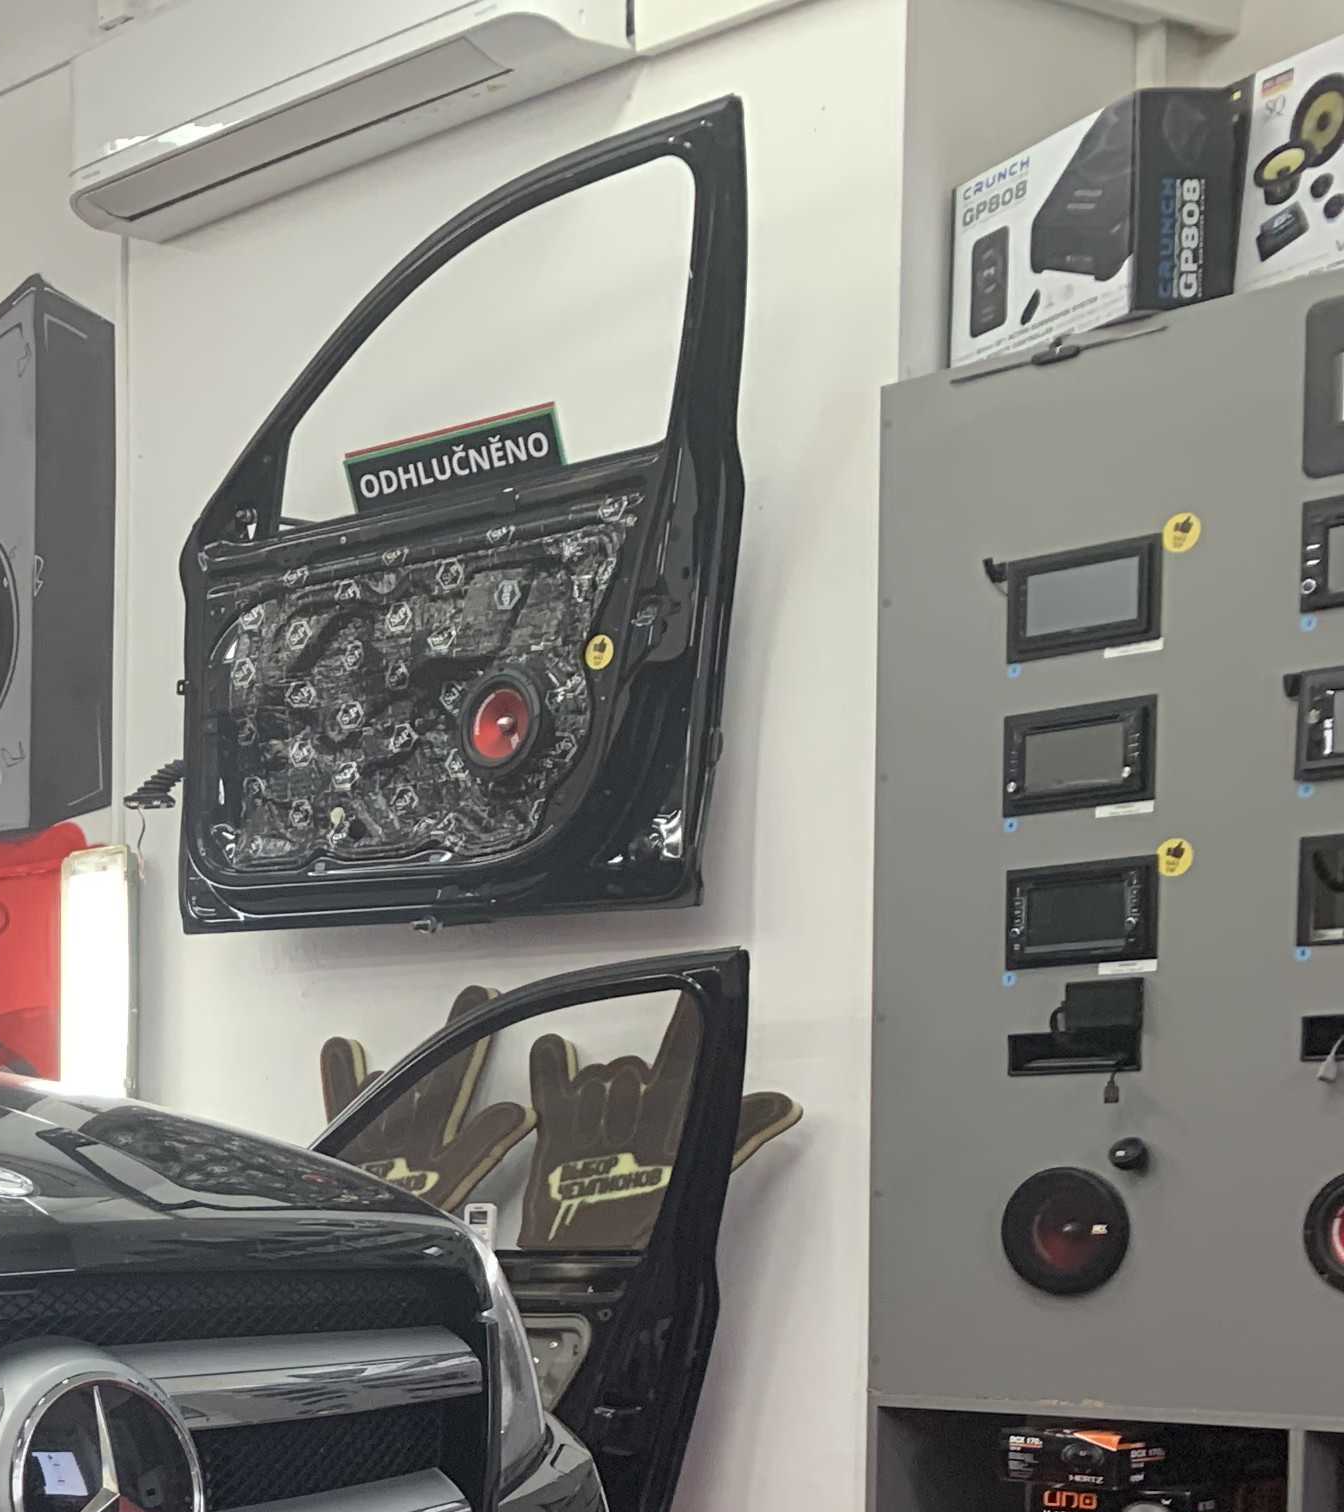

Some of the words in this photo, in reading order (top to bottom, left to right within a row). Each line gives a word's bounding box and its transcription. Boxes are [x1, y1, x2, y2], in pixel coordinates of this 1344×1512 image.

[963, 157, 1030, 200] CRUNCH
[963, 180, 1027, 226] GP808
[1180, 179, 1200, 298] GP808
[360, 432, 549, 498] ODHLUČNĚNO
[1069, 1474, 1104, 1484] HERTZ
